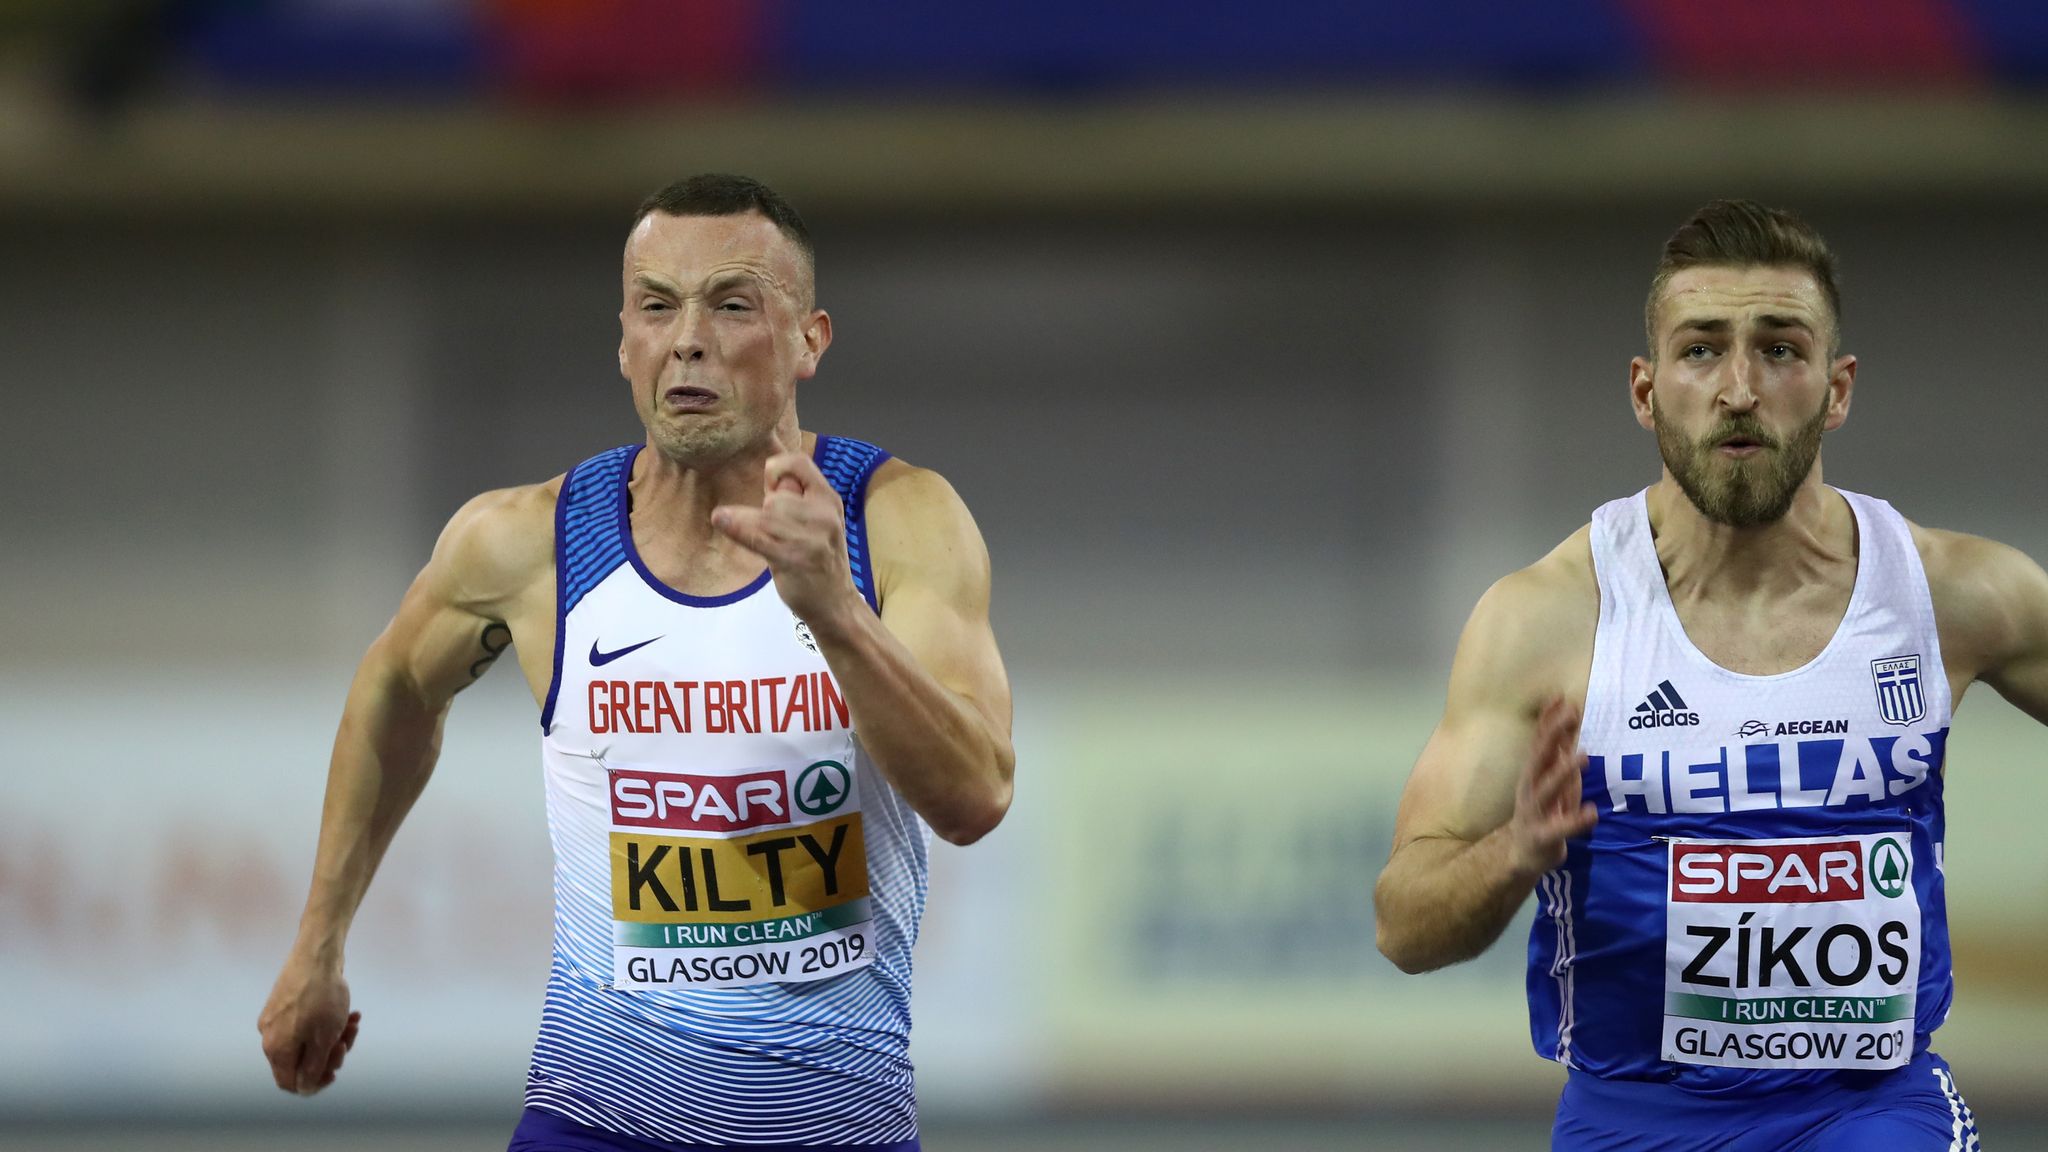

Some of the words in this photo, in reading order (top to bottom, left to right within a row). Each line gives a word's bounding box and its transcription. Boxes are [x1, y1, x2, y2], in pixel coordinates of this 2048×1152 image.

[588, 680, 699, 733] GREAT
[704, 671, 850, 733] BRITAIN
[1628, 709, 1700, 730] adidas
[1774, 719, 1849, 737] AEGEAN
[1605, 733, 1932, 815] HELLAS
[614, 779, 783, 822] SPAR
[627, 824, 849, 912] KILTY
[1678, 850, 1859, 895] SPAR
[627, 951, 791, 983] GLASGOW
[800, 933, 865, 974] 2019
[664, 930, 670, 944] I
[677, 928, 726, 944] RUN
[1681, 912, 1909, 989] ZÍKOS
[1721, 1000, 1728, 1019] I
[1735, 1001, 1786, 1020] RUN
[1675, 1027, 1848, 1060] GLASGOW
